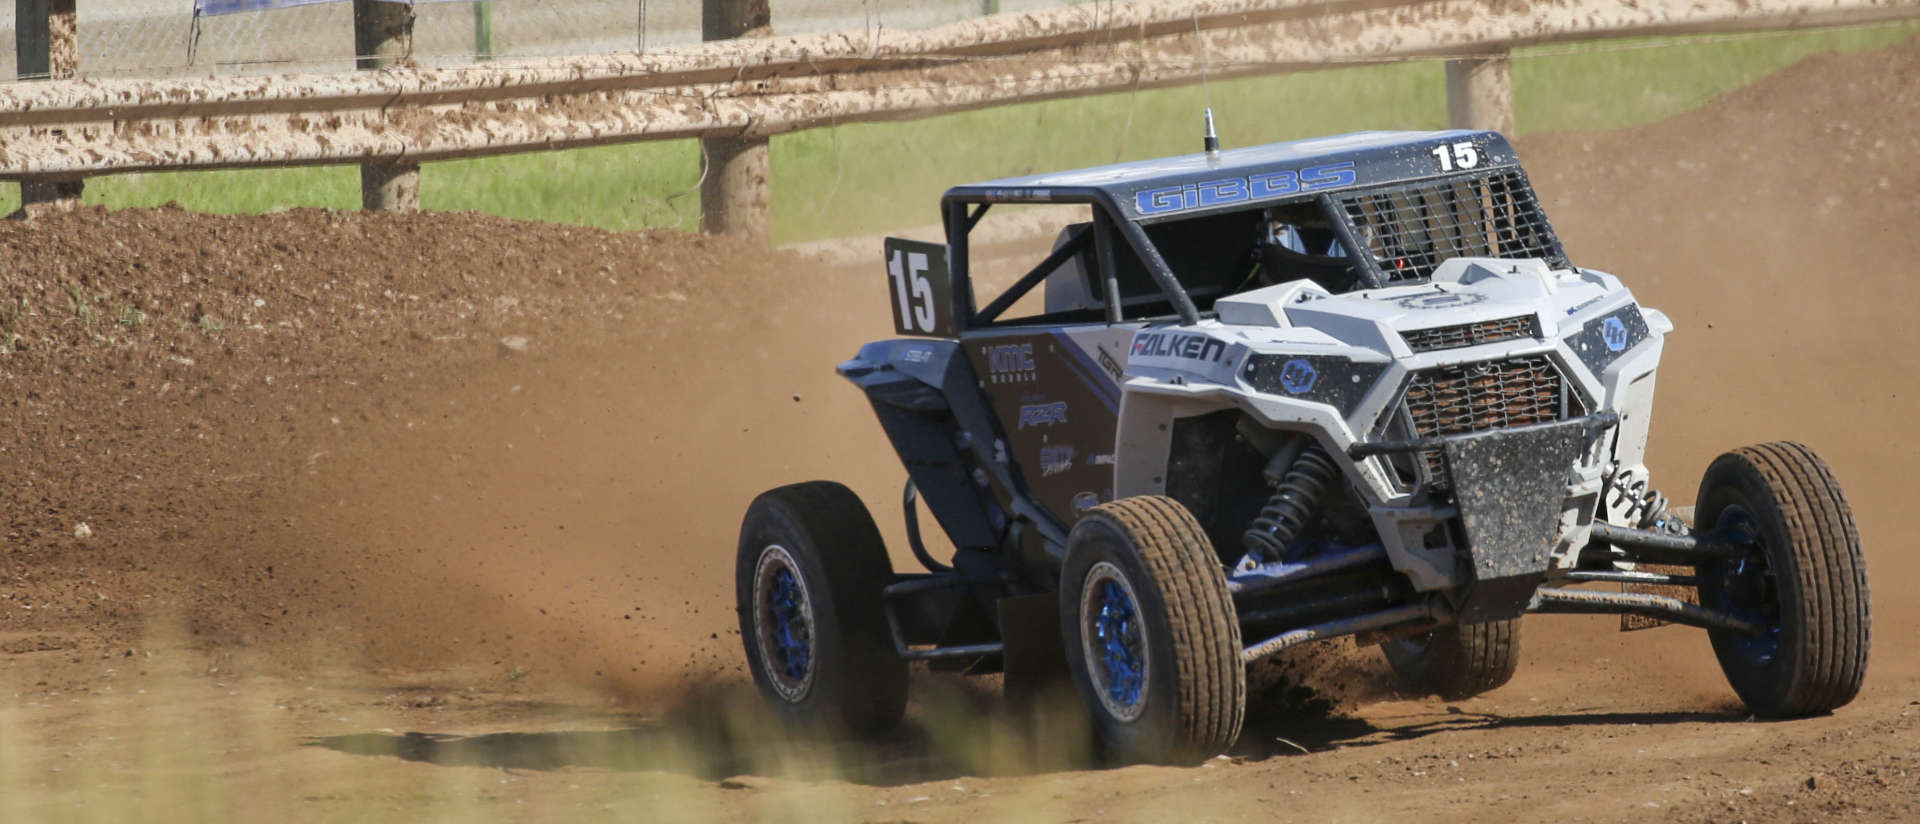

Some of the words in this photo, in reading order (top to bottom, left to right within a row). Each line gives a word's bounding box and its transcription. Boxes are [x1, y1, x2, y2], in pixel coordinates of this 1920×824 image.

[1433, 142, 1478, 171] 15
[888, 249, 936, 333] 15
[988, 344, 1035, 373] KMC
[1131, 333, 1226, 362] FALKEN
